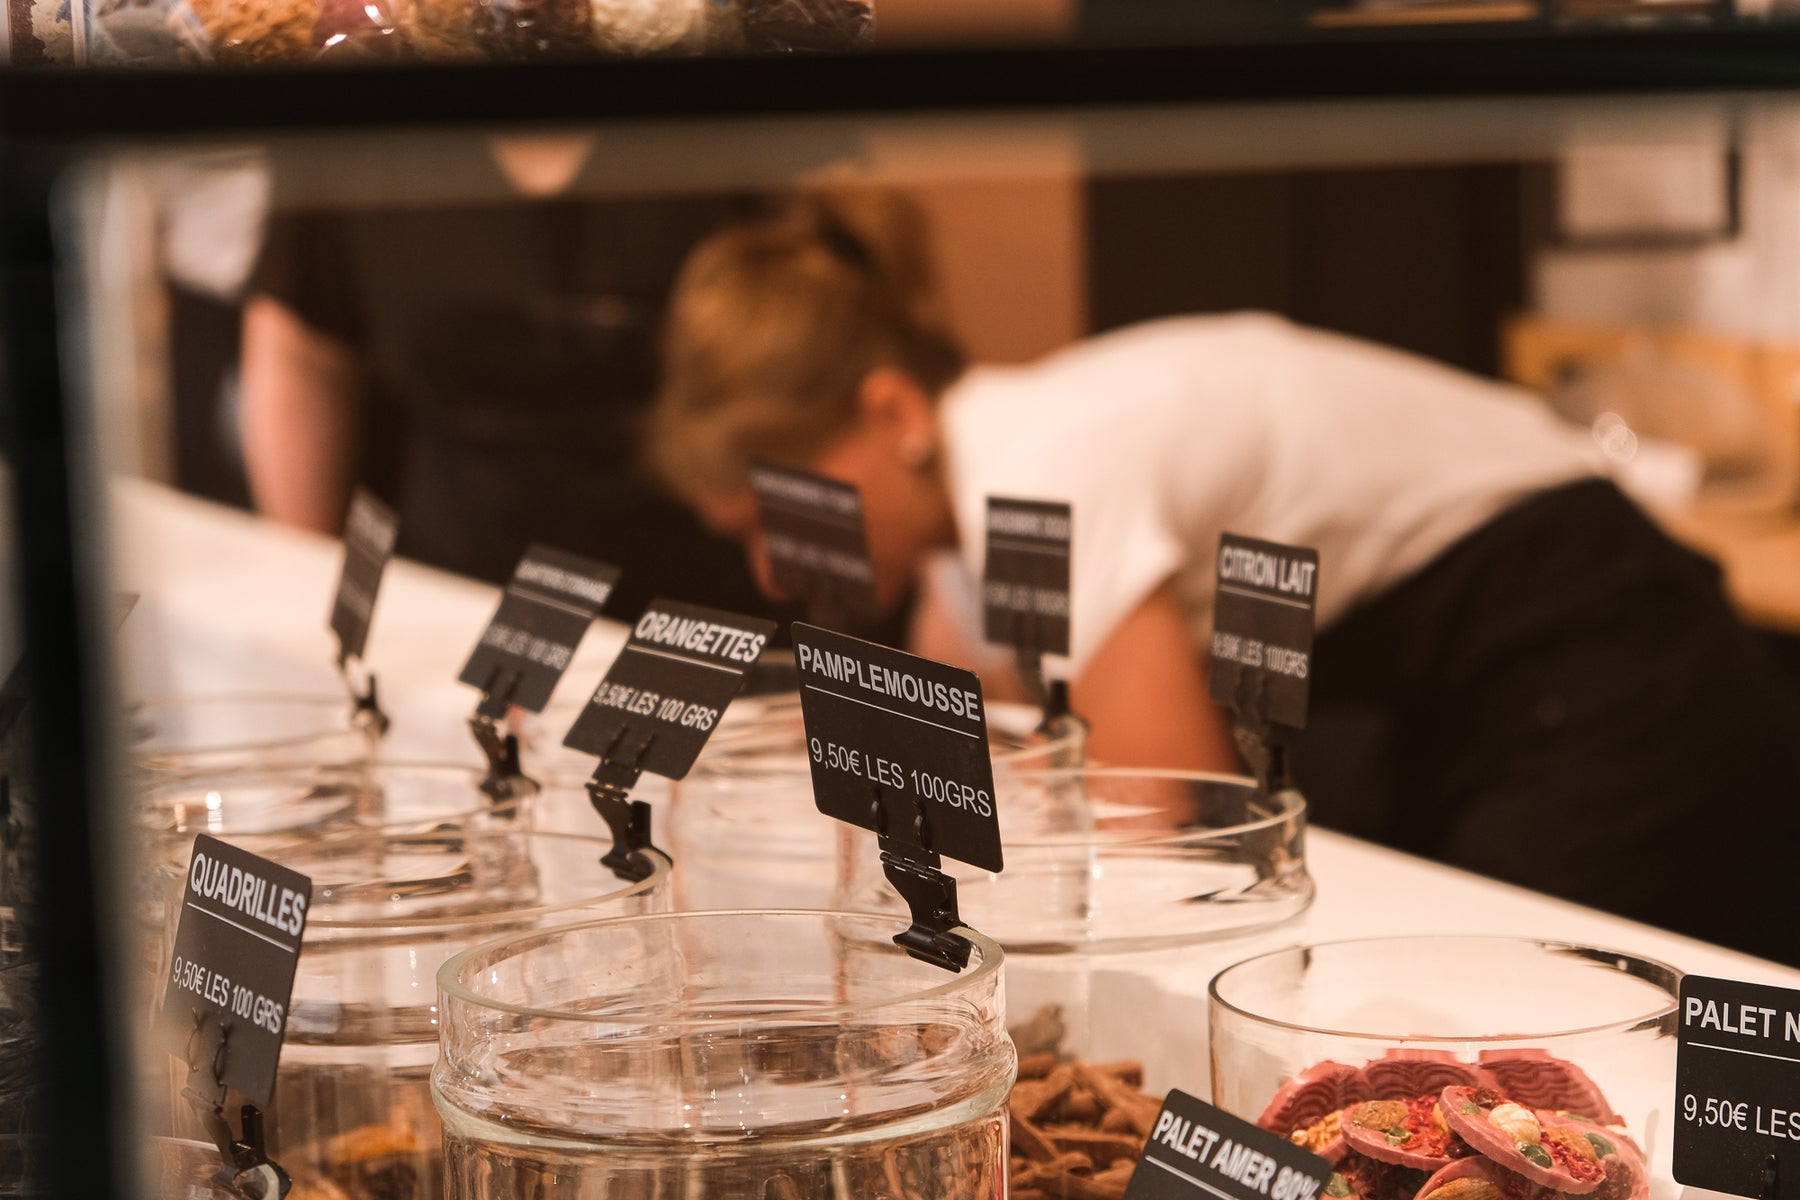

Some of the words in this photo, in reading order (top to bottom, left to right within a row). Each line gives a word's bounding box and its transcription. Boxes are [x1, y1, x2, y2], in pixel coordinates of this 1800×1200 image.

[1219, 545, 1277, 588] CITRON
[1277, 556, 1316, 596] LAIT
[635, 610, 766, 663] ORANGETTES
[1241, 640, 1263, 667] LES
[1265, 645, 1308, 679] 100GRS
[626, 687, 660, 716] LES
[656, 697, 686, 723] 100
[681, 704, 718, 731] GRS
[798, 643, 981, 722] PAMPLEMOUSSE
[811, 737, 862, 776] 9,50€
[865, 754, 905, 790] LES
[910, 769, 992, 818] 100GRS
[190, 852, 306, 936] QUADRILLES
[173, 956, 206, 995] 9,50€
[204, 971, 230, 1007] LES
[231, 984, 254, 1019] 100
[253, 995, 284, 1034] GRS
[1685, 996, 1777, 1038] PALET
[1683, 1093, 1749, 1131] 9,50€
[1152, 1109, 1221, 1164] PALET
[1209, 1138, 1278, 1195] AMER
